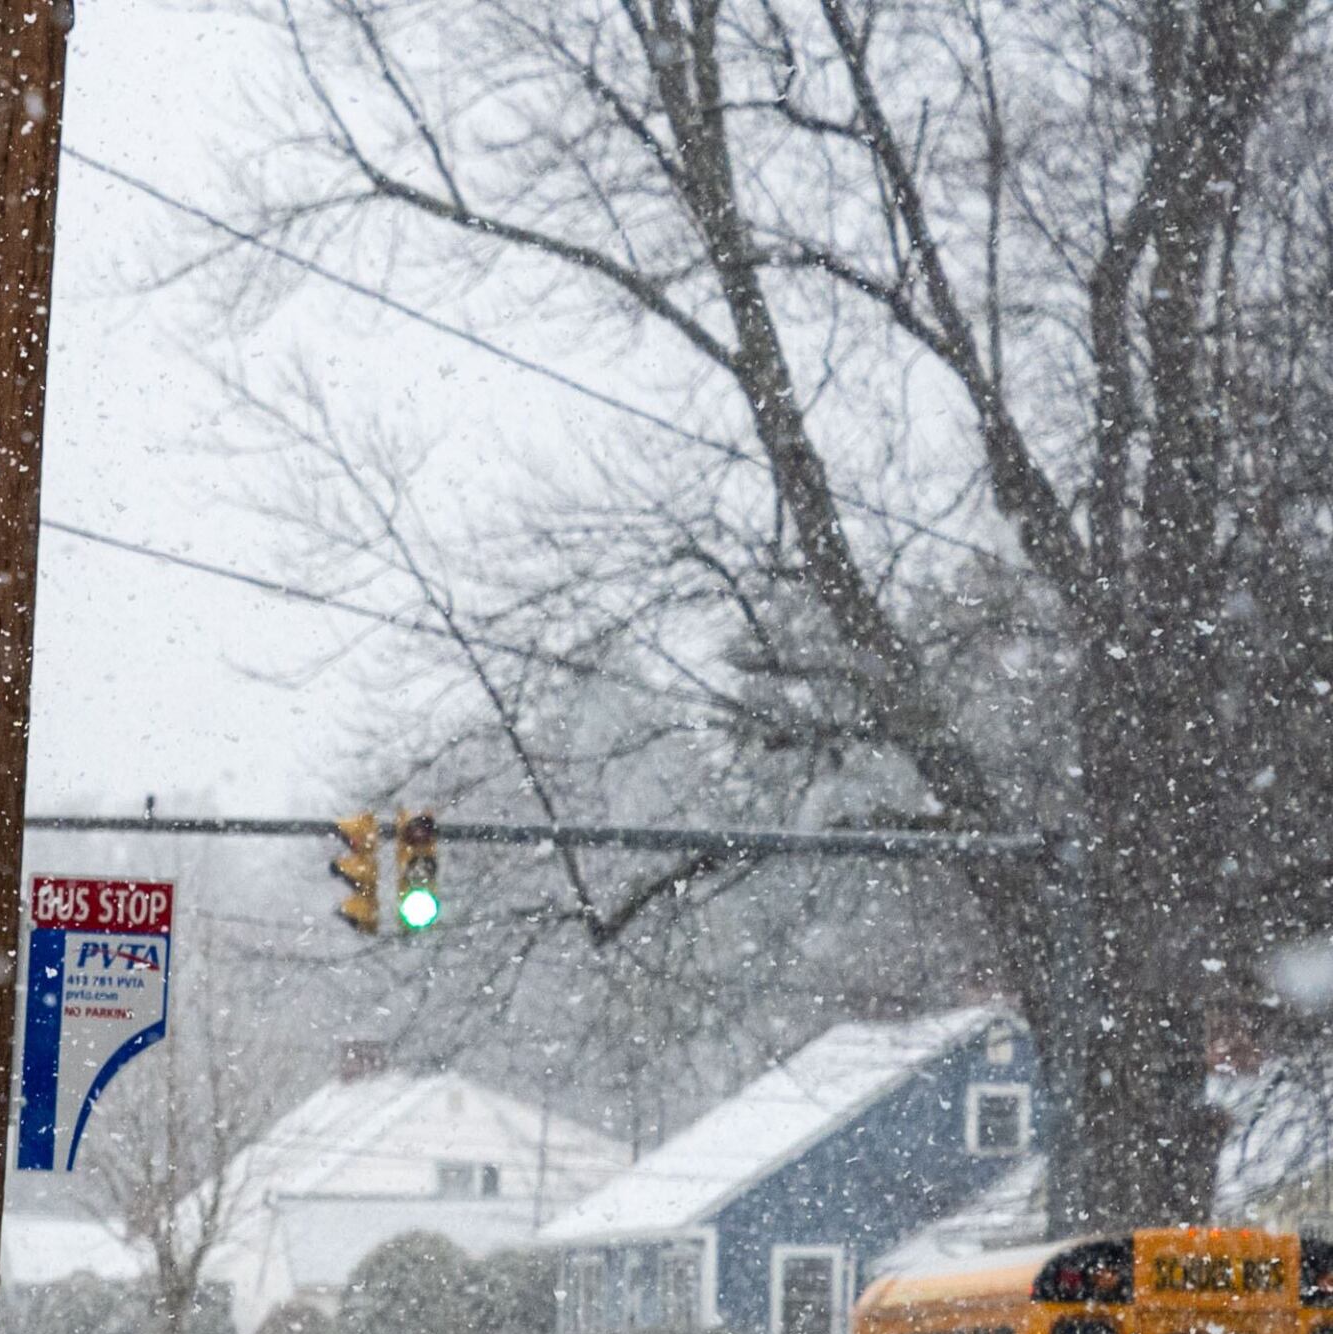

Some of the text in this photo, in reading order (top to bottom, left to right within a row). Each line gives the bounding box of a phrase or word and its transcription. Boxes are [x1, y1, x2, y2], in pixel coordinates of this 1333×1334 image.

[37, 884, 167, 925] BUS STOP
[77, 942, 160, 971] PVTA
[66, 974, 88, 986] 413
[117, 976, 145, 989] PVTA
[64, 1005, 81, 1017] NO
